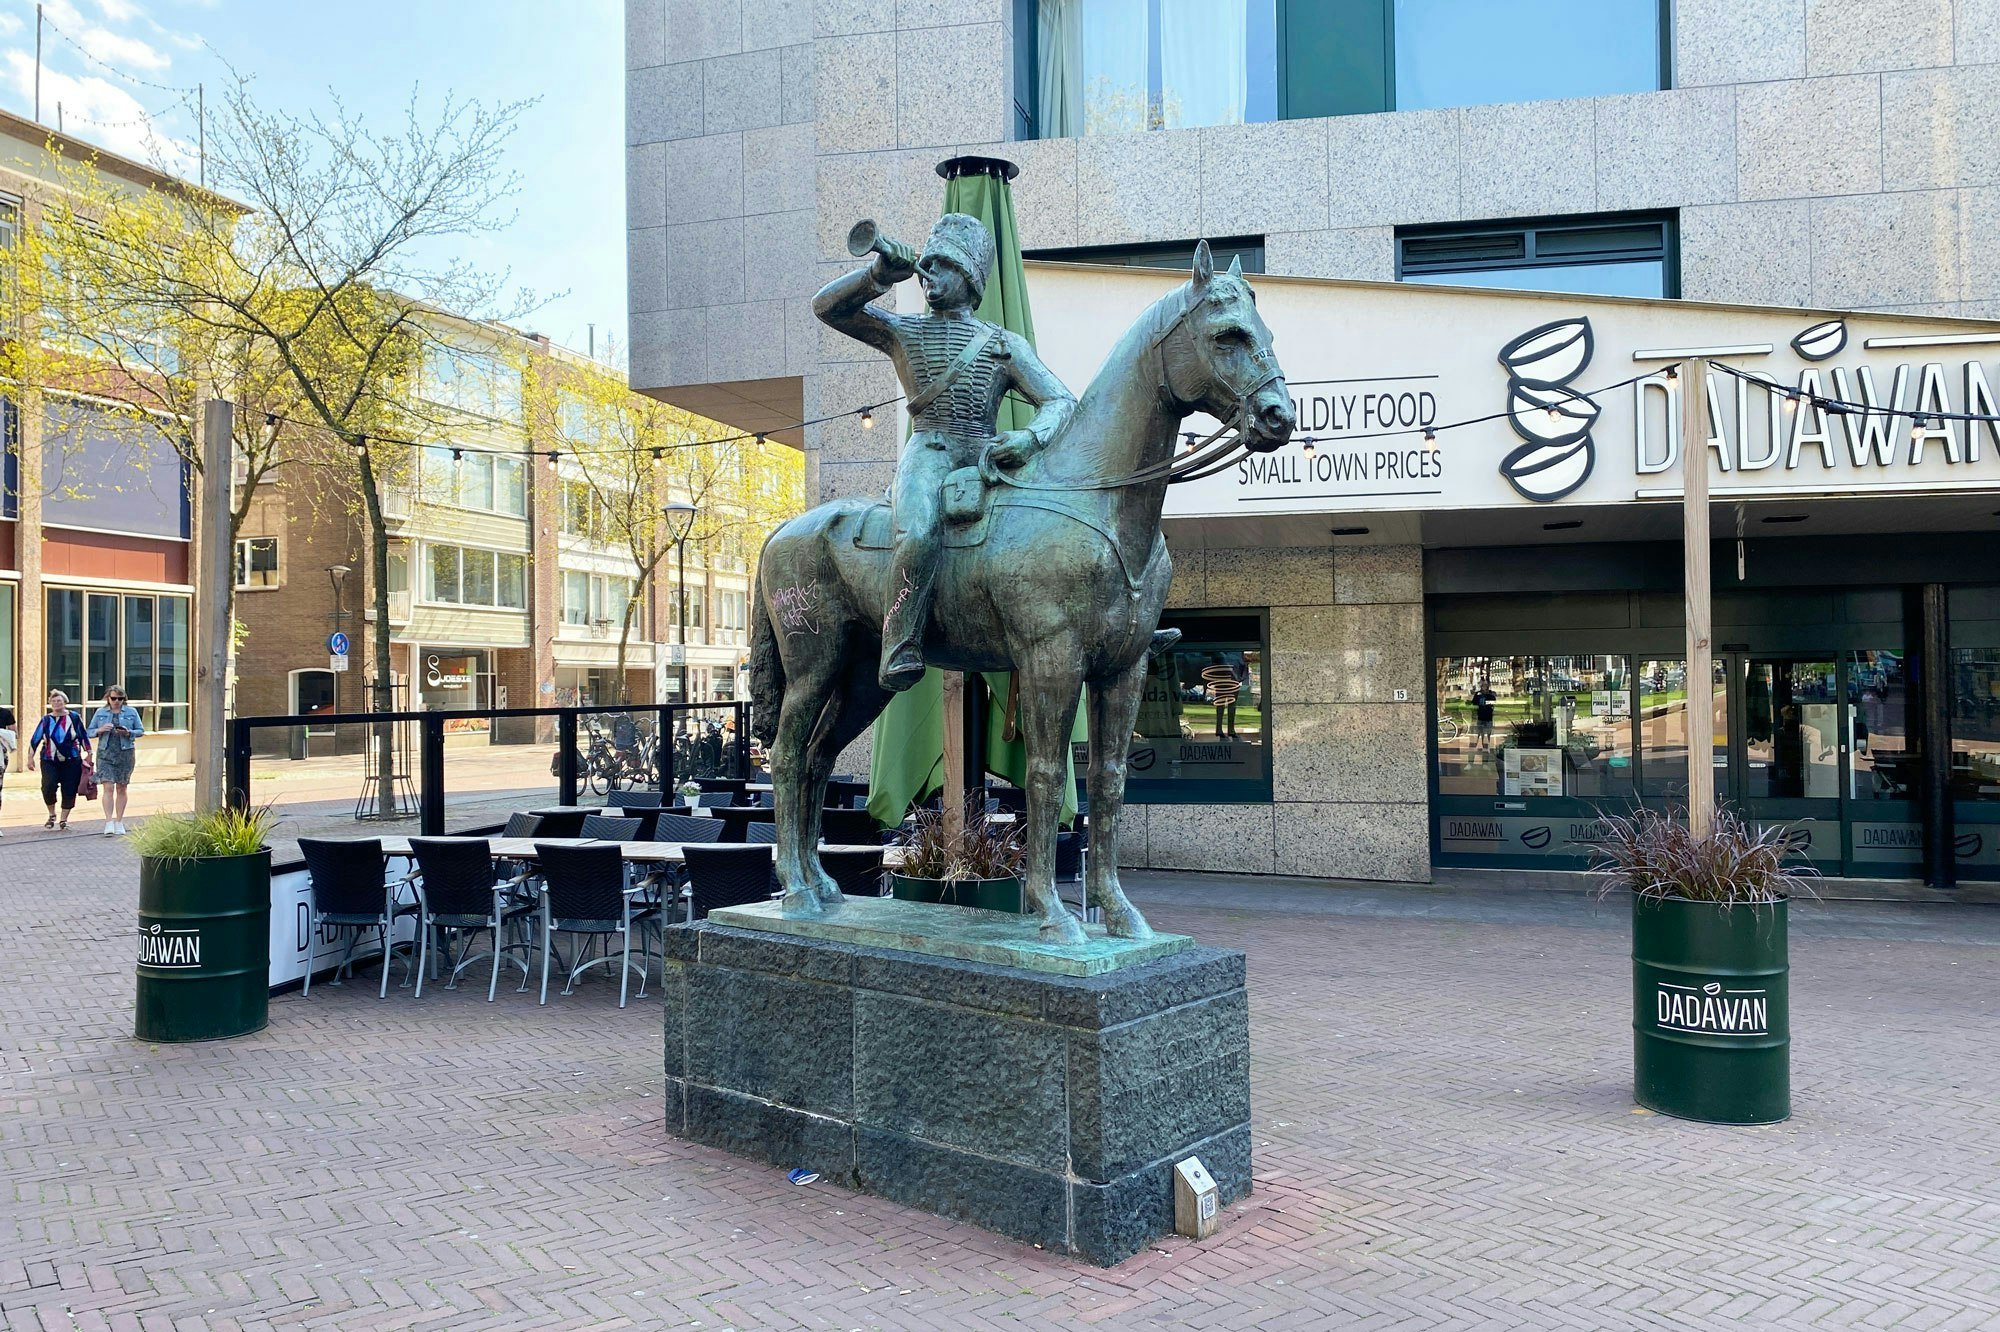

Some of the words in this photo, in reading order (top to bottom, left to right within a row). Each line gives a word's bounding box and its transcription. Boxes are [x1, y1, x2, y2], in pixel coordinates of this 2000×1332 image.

[1292, 395, 1356, 432] LDLY
[1363, 391, 1436, 429] FOOD
[1238, 455, 1301, 485] SMALL
[1308, 452, 1368, 482] TOWN
[1375, 449, 1442, 480] PRICES
[1396, 690, 1405, 699] 15
[1180, 745, 1232, 761] DADAWAN
[1450, 821, 1503, 838] DADAWAN
[1570, 823, 1614, 839] DADAW
[138, 935, 200, 964] ADAWAN
[1658, 990, 1767, 1030] DADAWAN
